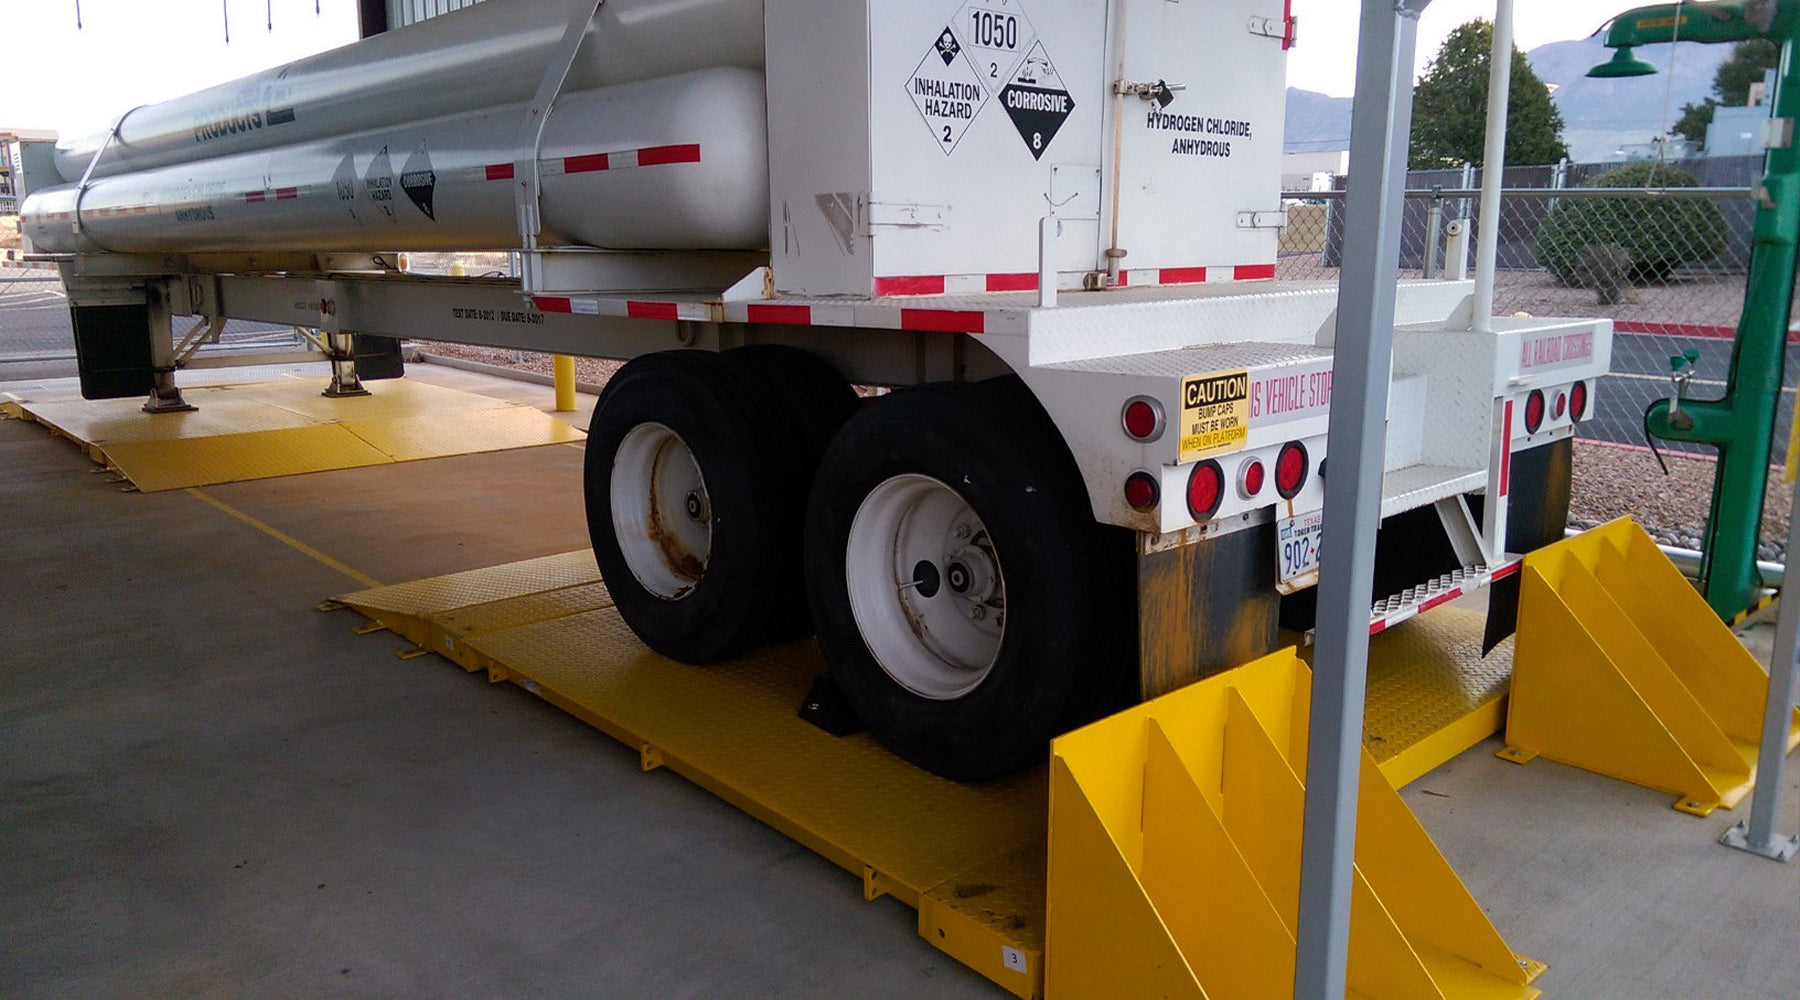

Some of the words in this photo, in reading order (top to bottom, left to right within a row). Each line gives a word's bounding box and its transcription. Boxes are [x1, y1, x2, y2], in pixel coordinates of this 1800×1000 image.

[972, 11, 1016, 49] 1050
[990, 63, 998, 78] 2
[915, 78, 980, 101] INHALATION
[925, 99, 972, 119] HAZARD
[1007, 90, 1068, 113] CORROSIVE
[194, 112, 262, 142] PRODUCTS
[943, 125, 952, 142] 2
[1147, 112, 1203, 133] HYDROGEN
[1206, 118, 1252, 140] CHLORIDE,
[1033, 132, 1042, 149] 8
[1172, 138, 1231, 157] ANHYDROUS
[403, 172, 434, 188] CORROSIVE
[452, 308, 463, 319] TEST
[465, 308, 477, 320] DATE:
[501, 310, 511, 322] DUE
[512, 311, 525, 323] DATE:
[1187, 376, 1246, 406] CAUTION
[1250, 381, 1262, 418] IS
[1265, 374, 1306, 415] VEHICLE
[1309, 370, 1333, 408] STOP
[1198, 405, 1216, 420] BUMP
[1217, 402, 1234, 416] CAPS
[1192, 420, 1210, 435] MUST
[1210, 419, 1219, 432] BE
[1220, 415, 1239, 430] WORN
[1182, 436, 1202, 451] WHEN
[1202, 433, 1212, 447] ON
[1212, 427, 1246, 444] PLATFORM
[1304, 515, 1321, 526] TEXAS
[1284, 536, 1310, 574] 902
[1012, 953, 1018, 963] 3
